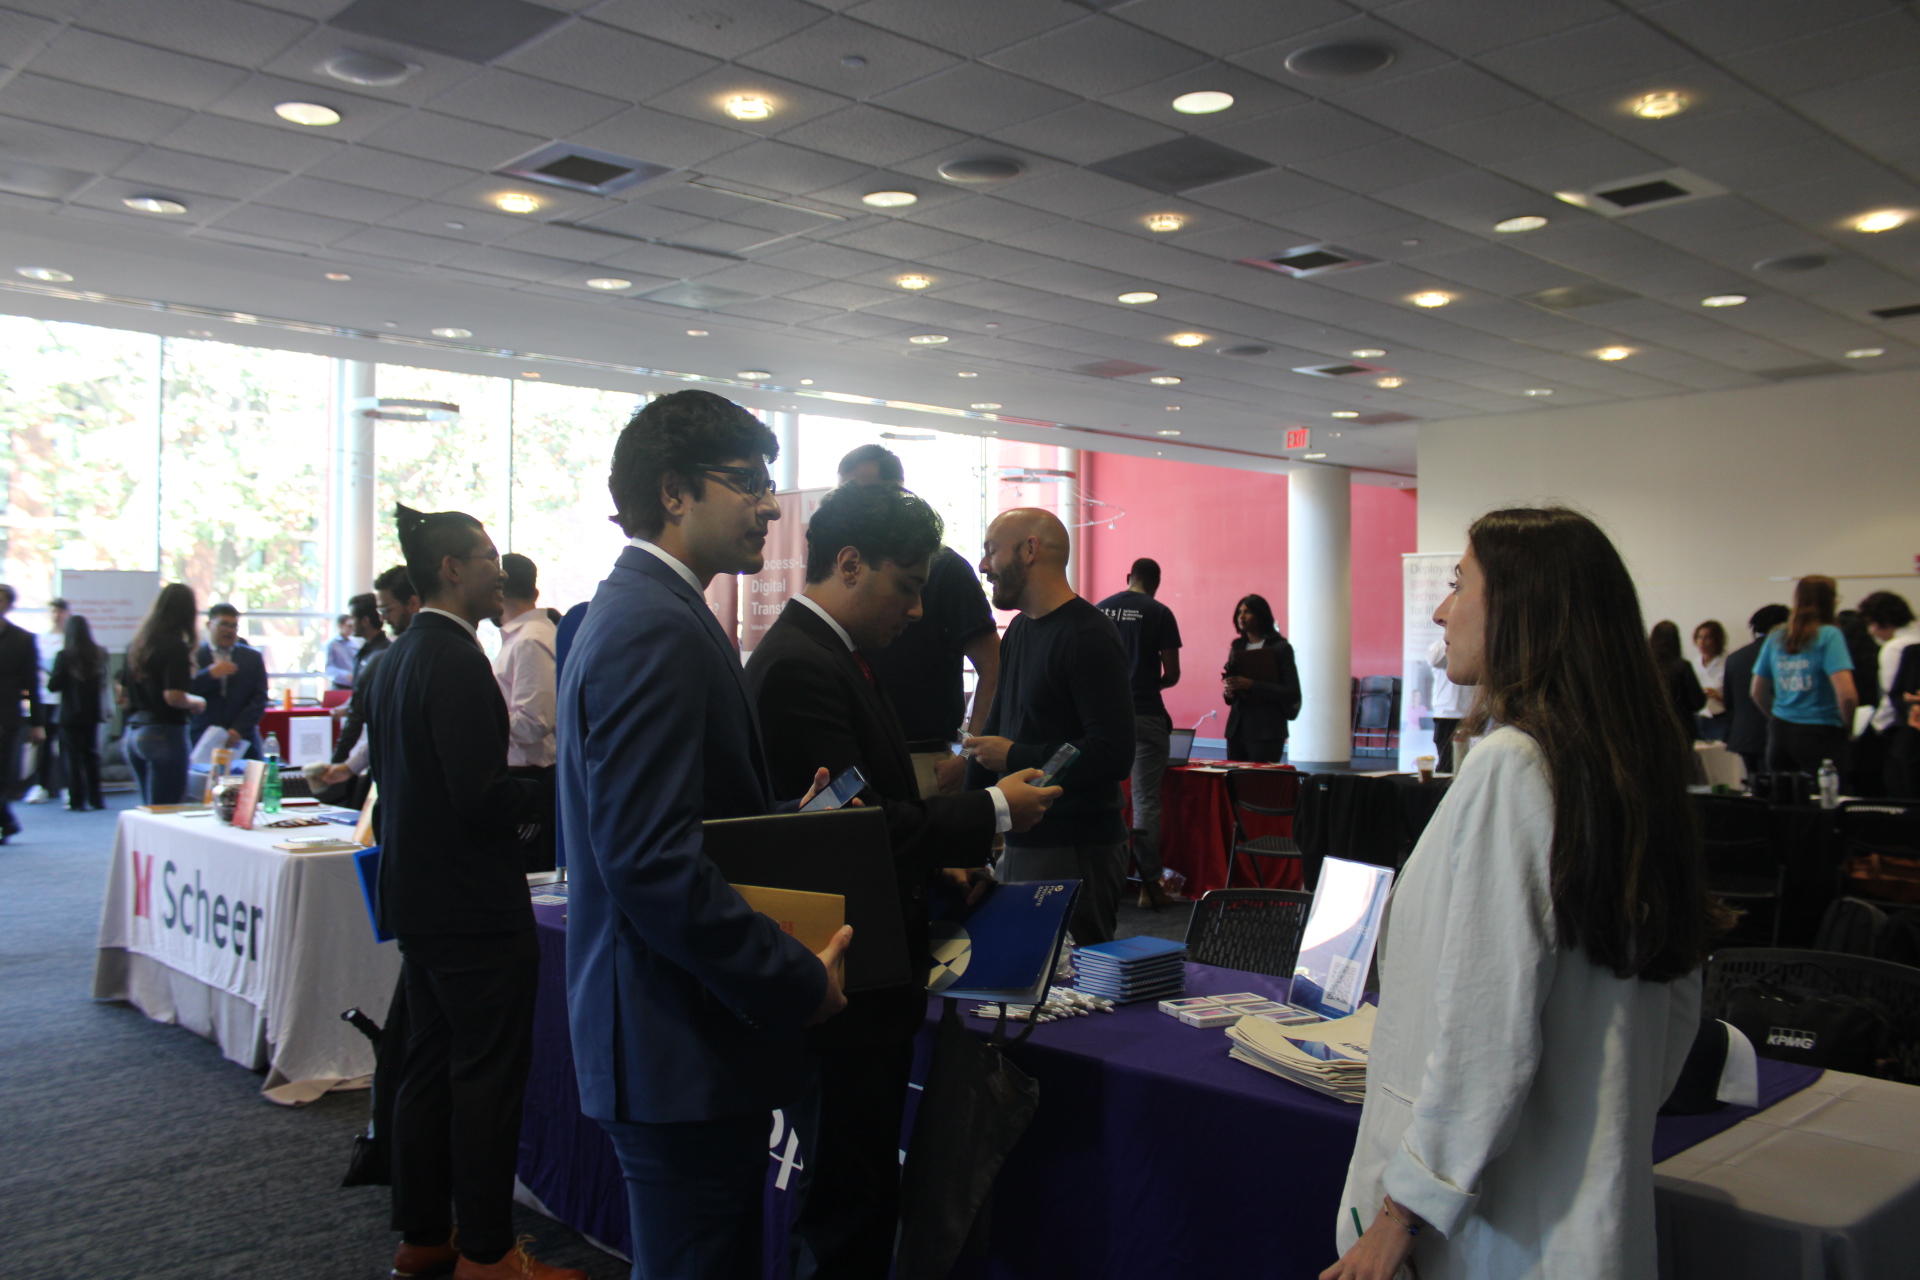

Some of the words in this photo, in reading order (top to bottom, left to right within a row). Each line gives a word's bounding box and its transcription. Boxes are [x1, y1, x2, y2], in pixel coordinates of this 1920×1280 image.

[1287, 429, 1308, 449] EXIT
[763, 554, 807, 571] ocess-L
[751, 578, 786, 596] Digital
[751, 601, 786, 616] Transf
[162, 860, 264, 962] Scheer
[1766, 1033, 1815, 1049] KPMG
